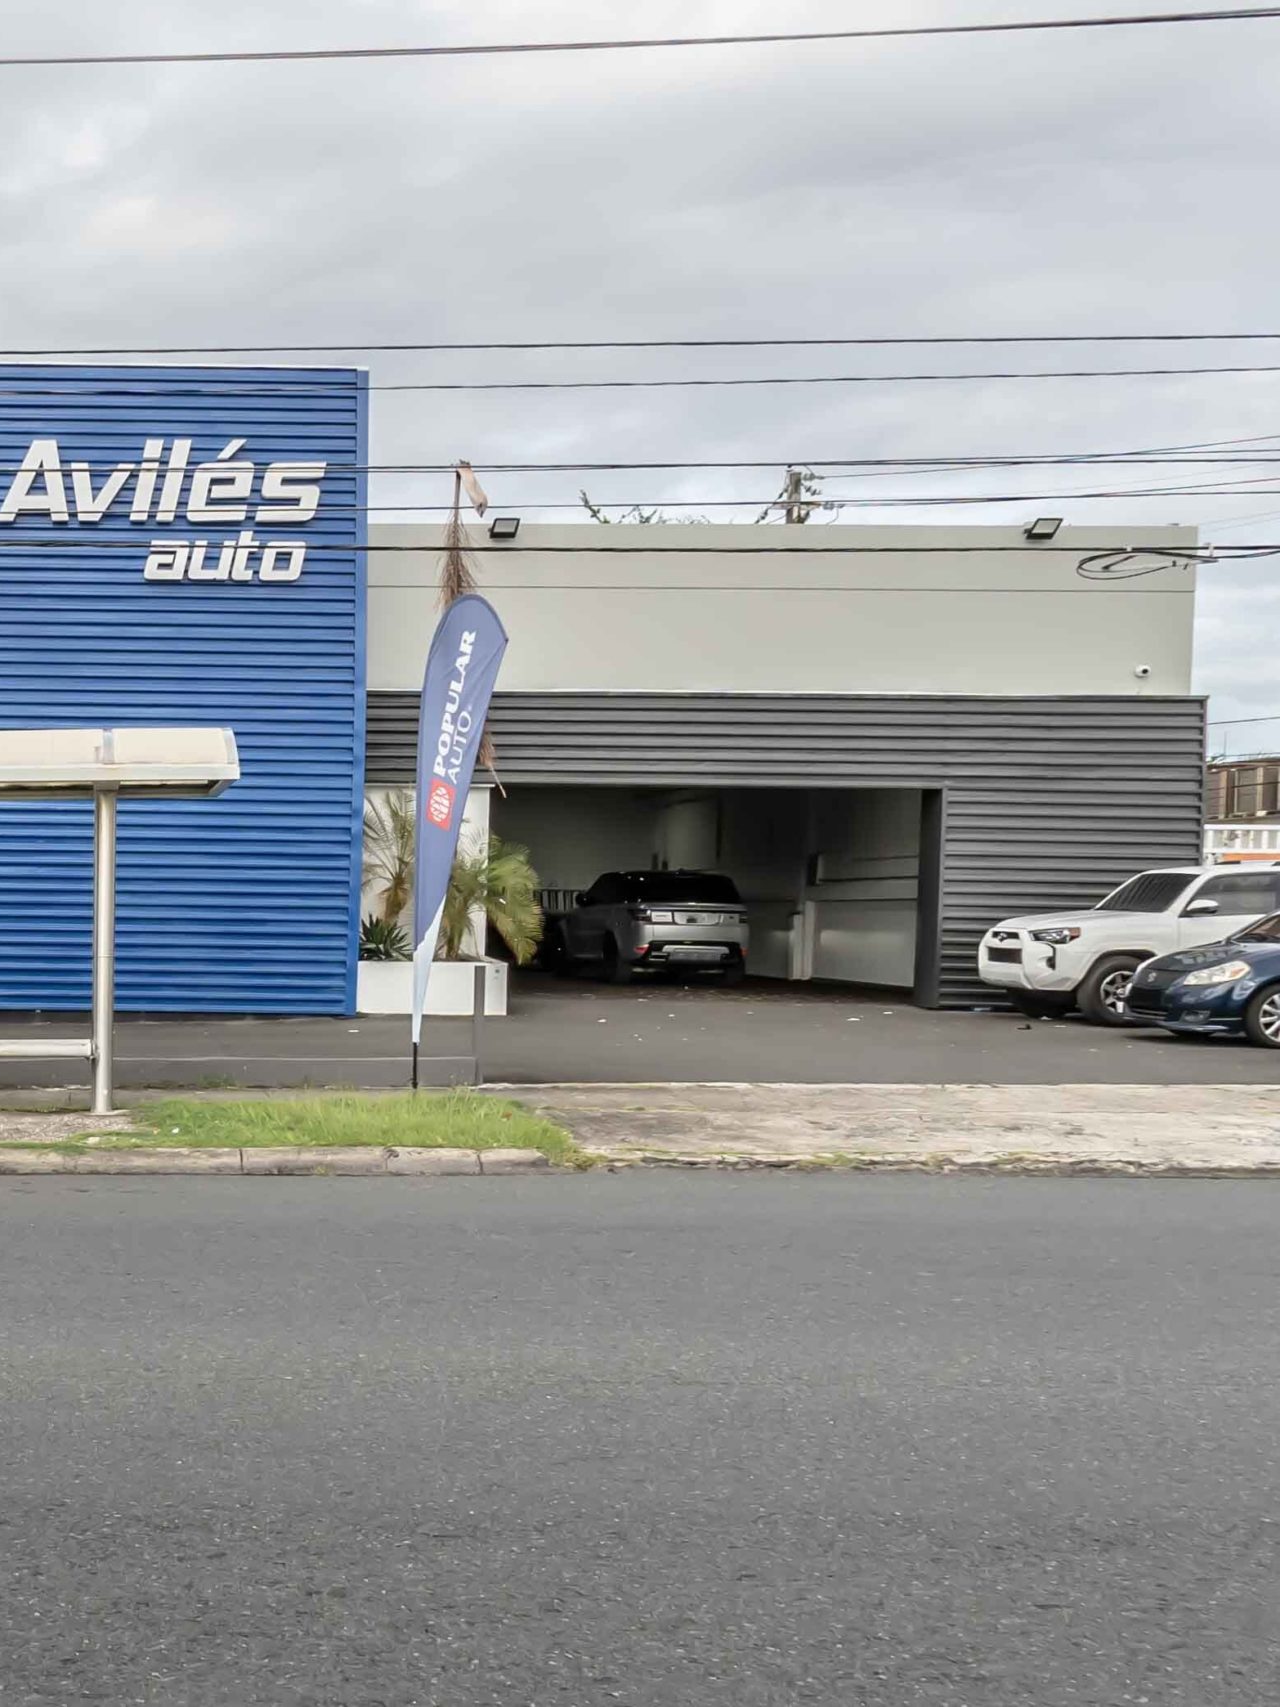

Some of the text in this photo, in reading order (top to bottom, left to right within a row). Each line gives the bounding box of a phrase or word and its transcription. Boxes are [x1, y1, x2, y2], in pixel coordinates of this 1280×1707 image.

[143, 530, 307, 582] auto
[433, 629, 477, 777] POPULAR
[446, 710, 472, 785] AUTO
